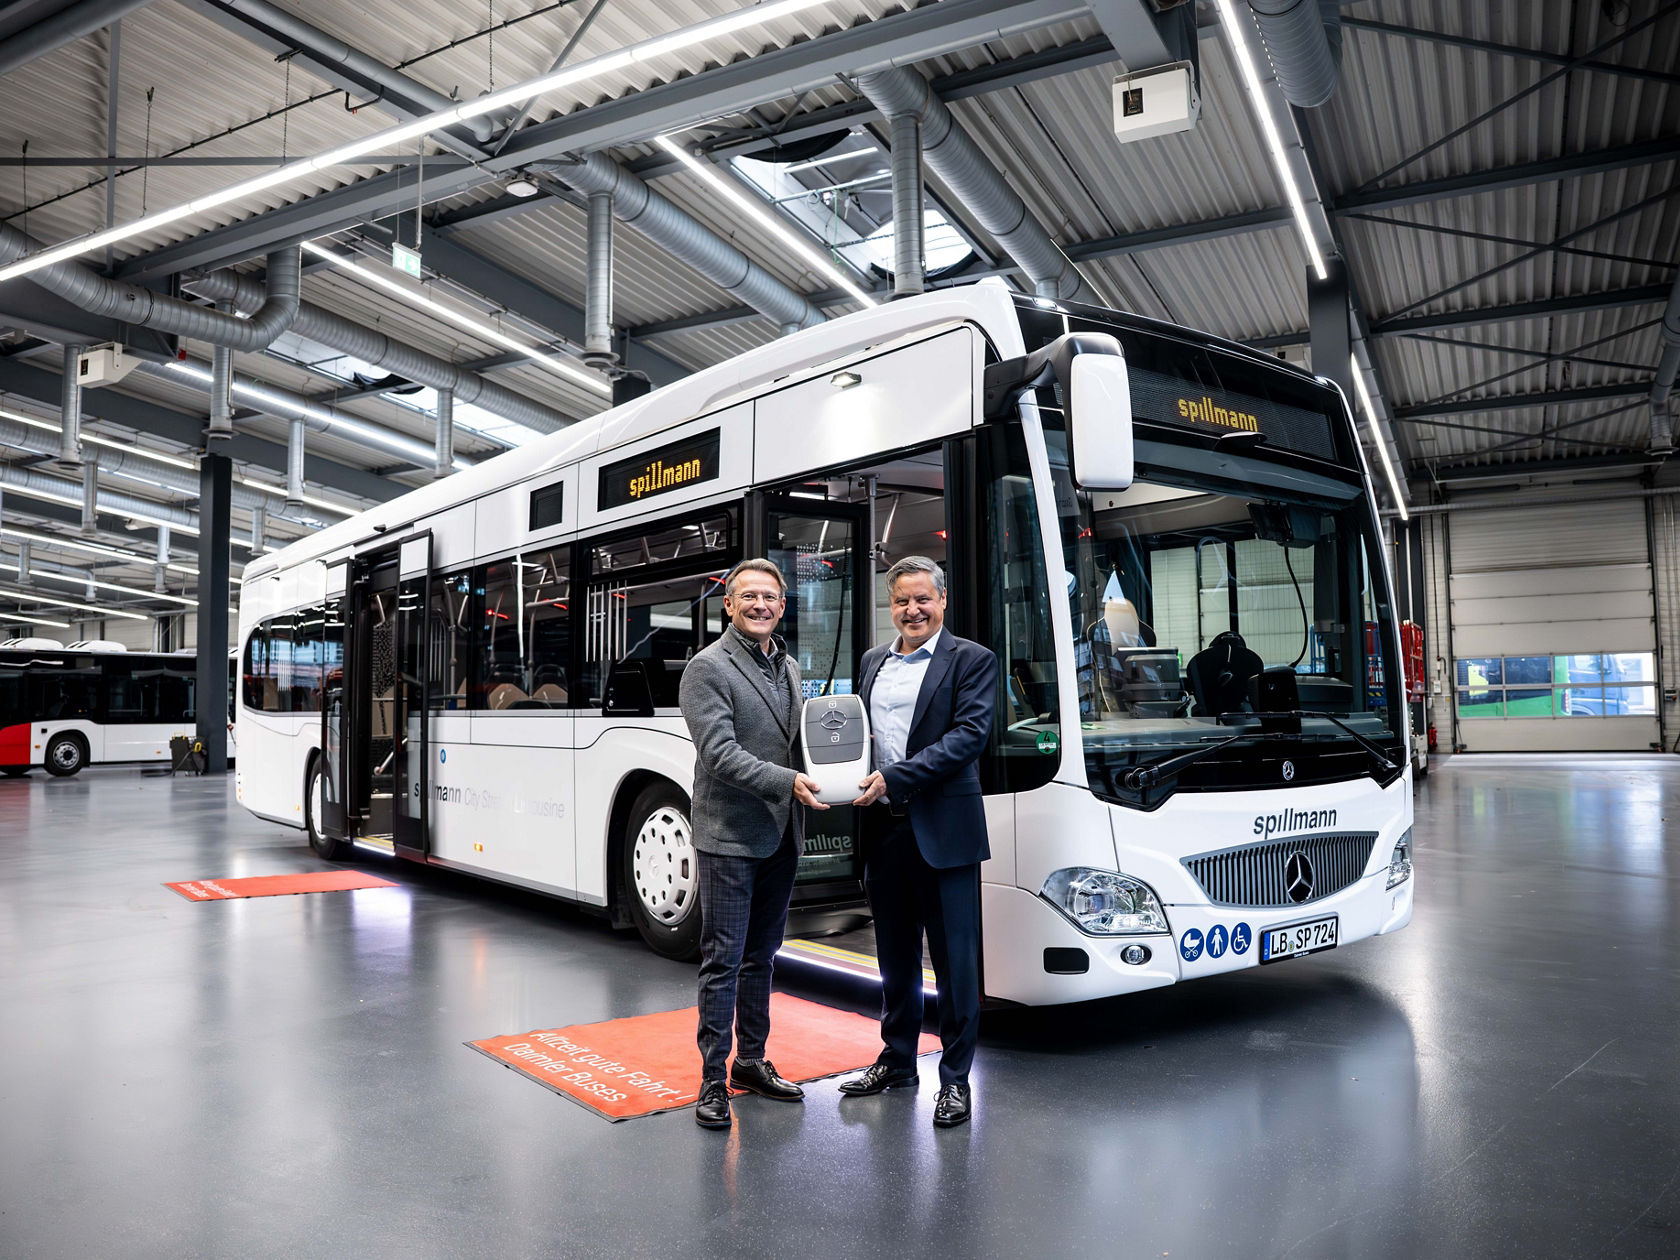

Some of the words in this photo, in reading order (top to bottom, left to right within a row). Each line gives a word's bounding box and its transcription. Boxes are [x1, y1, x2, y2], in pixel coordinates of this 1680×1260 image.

[1178, 396, 1258, 432] spillmann
[629, 458, 701, 498] spillmann
[1253, 808, 1337, 839] spillmann
[1271, 932, 1288, 955] LB
[1295, 927, 1311, 949] SP
[1314, 921, 1335, 945] 724
[503, 1043, 573, 1075] Daimler
[561, 1071, 627, 1103] Buses
[529, 1032, 590, 1056] Allzeit
[578, 1053, 626, 1075] gute
[619, 1071, 681, 1099] Fahrt
